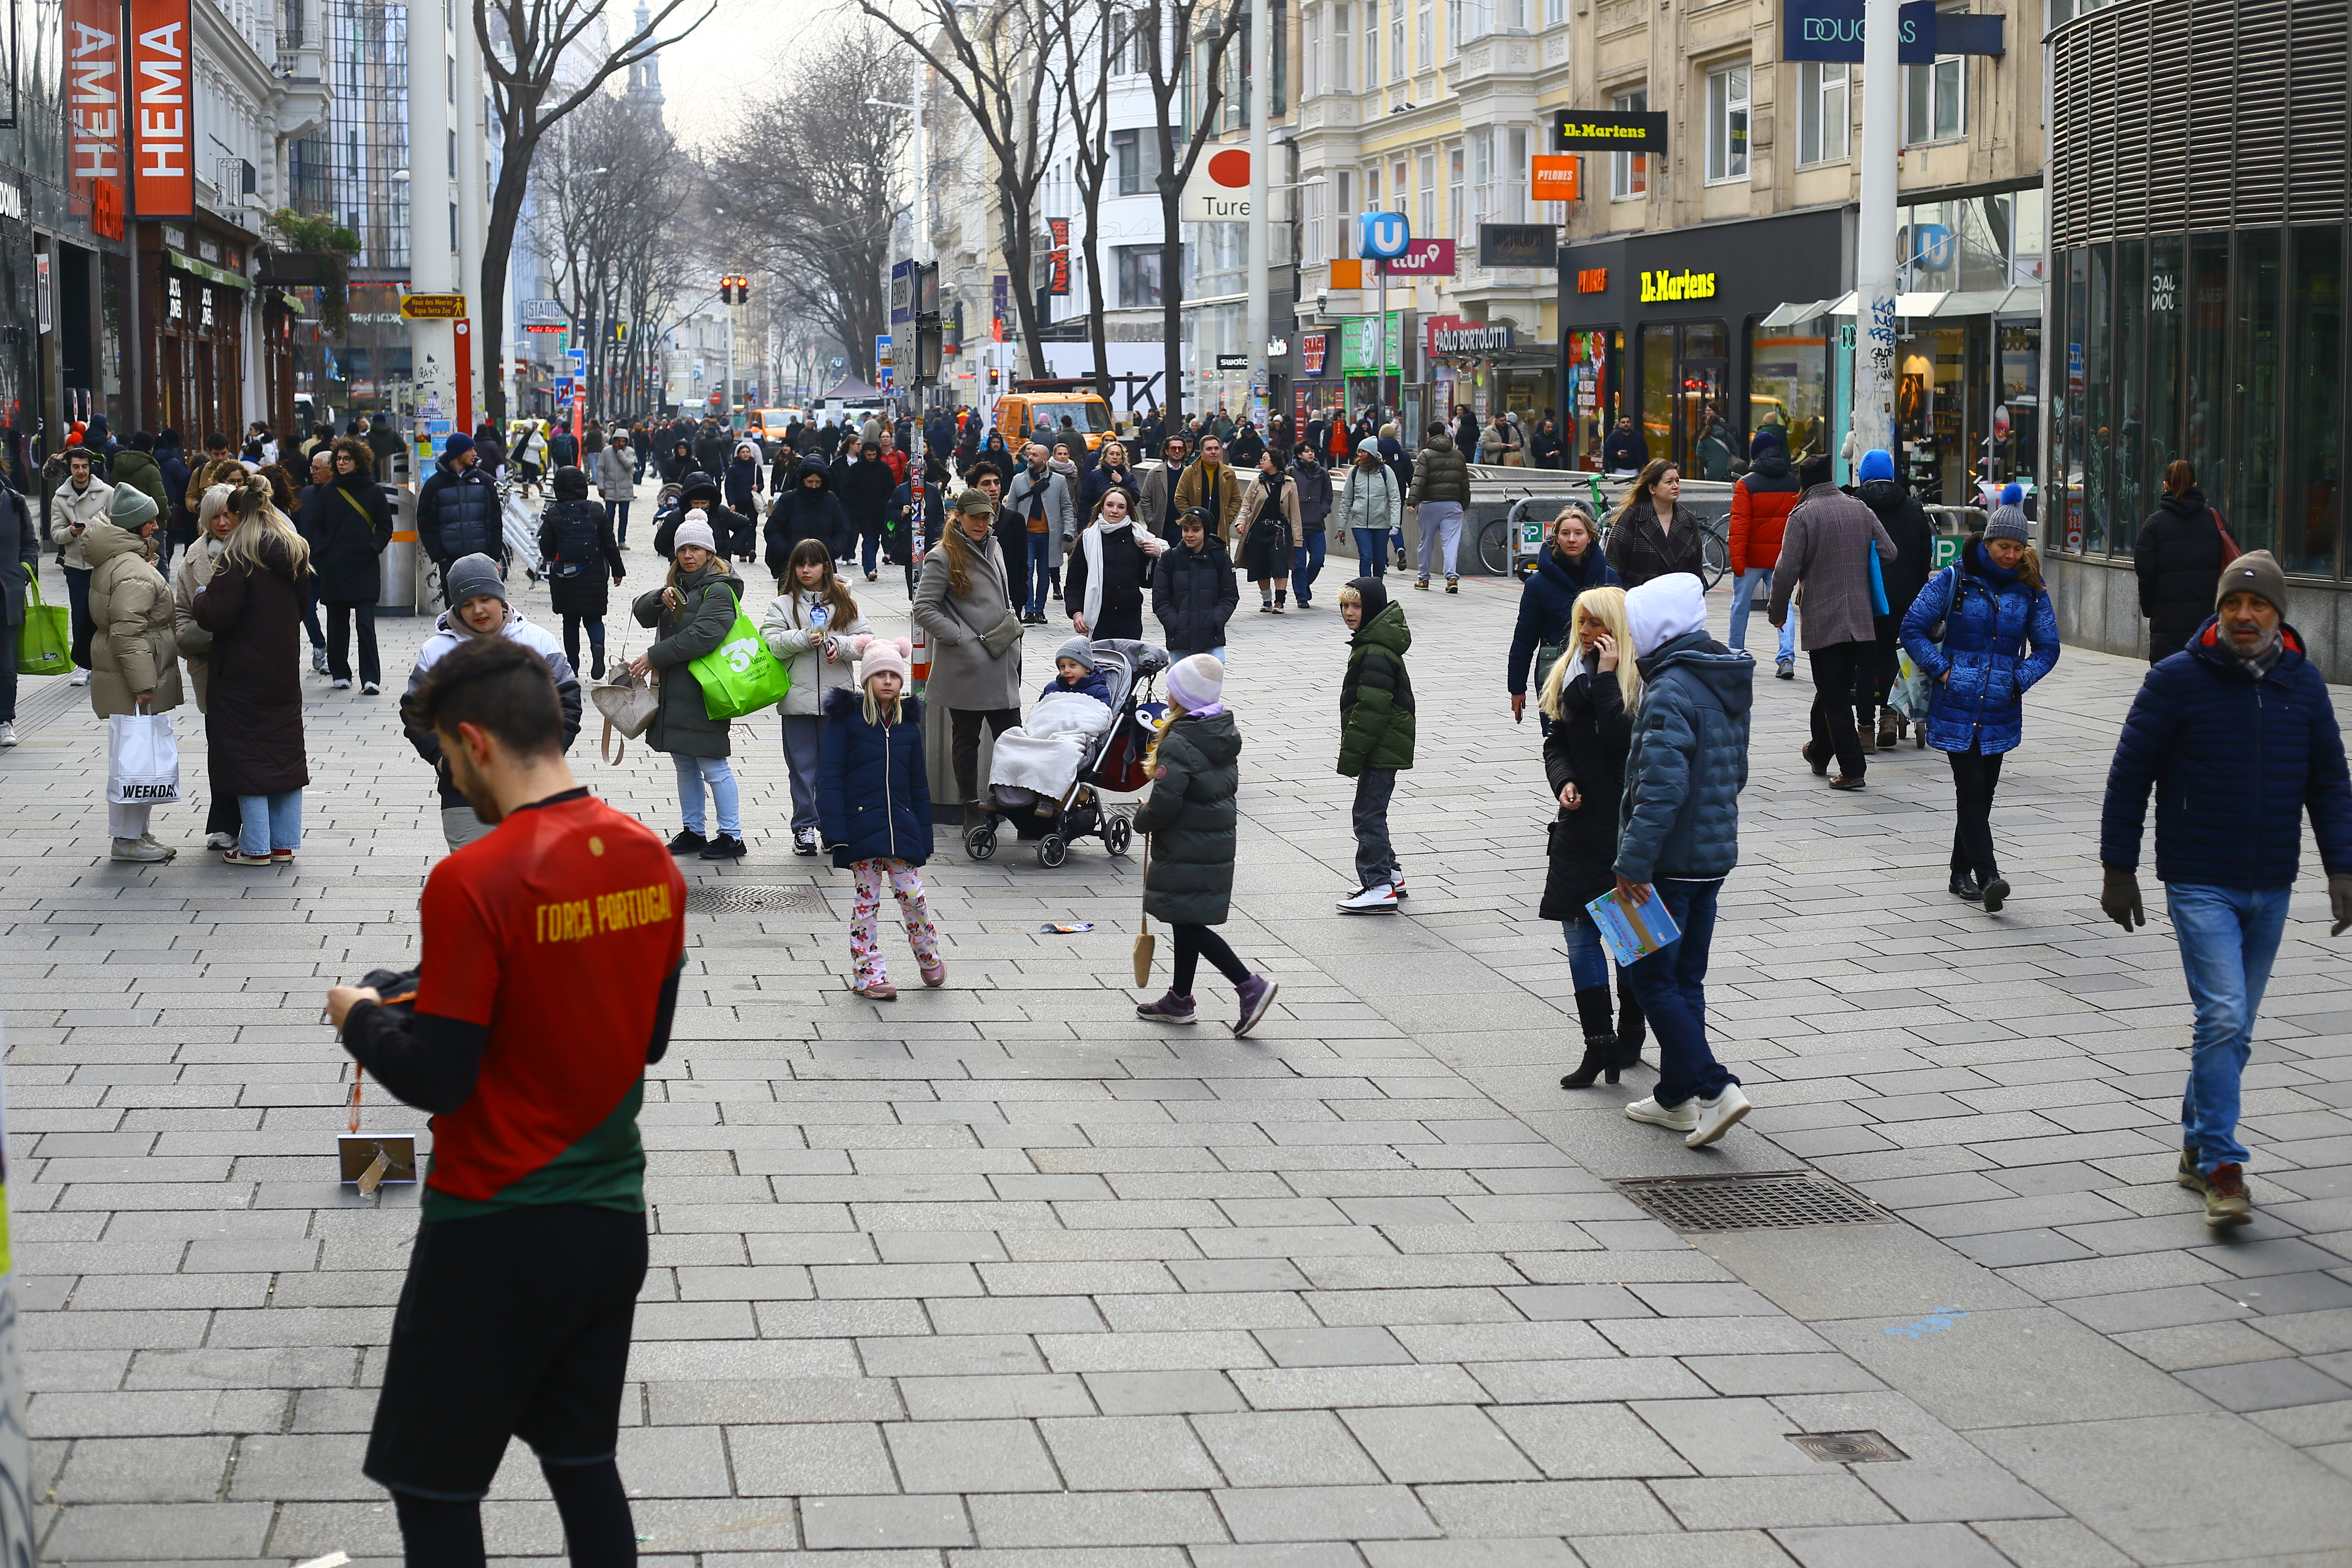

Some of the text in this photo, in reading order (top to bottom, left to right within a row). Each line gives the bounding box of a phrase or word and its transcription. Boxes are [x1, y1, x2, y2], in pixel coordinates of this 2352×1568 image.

[1804, 18, 1916, 43] DOUGS
[140, 21, 184, 176] HEMA
[1538, 169, 1573, 180] PYLONES
[1203, 196, 1250, 215] Ture
[1375, 222, 1402, 252] U
[1434, 326, 1507, 352] PAOLO BORTOLOTTI
[1221, 357, 1248, 366] swatc
[1937, 540, 1956, 566] P
